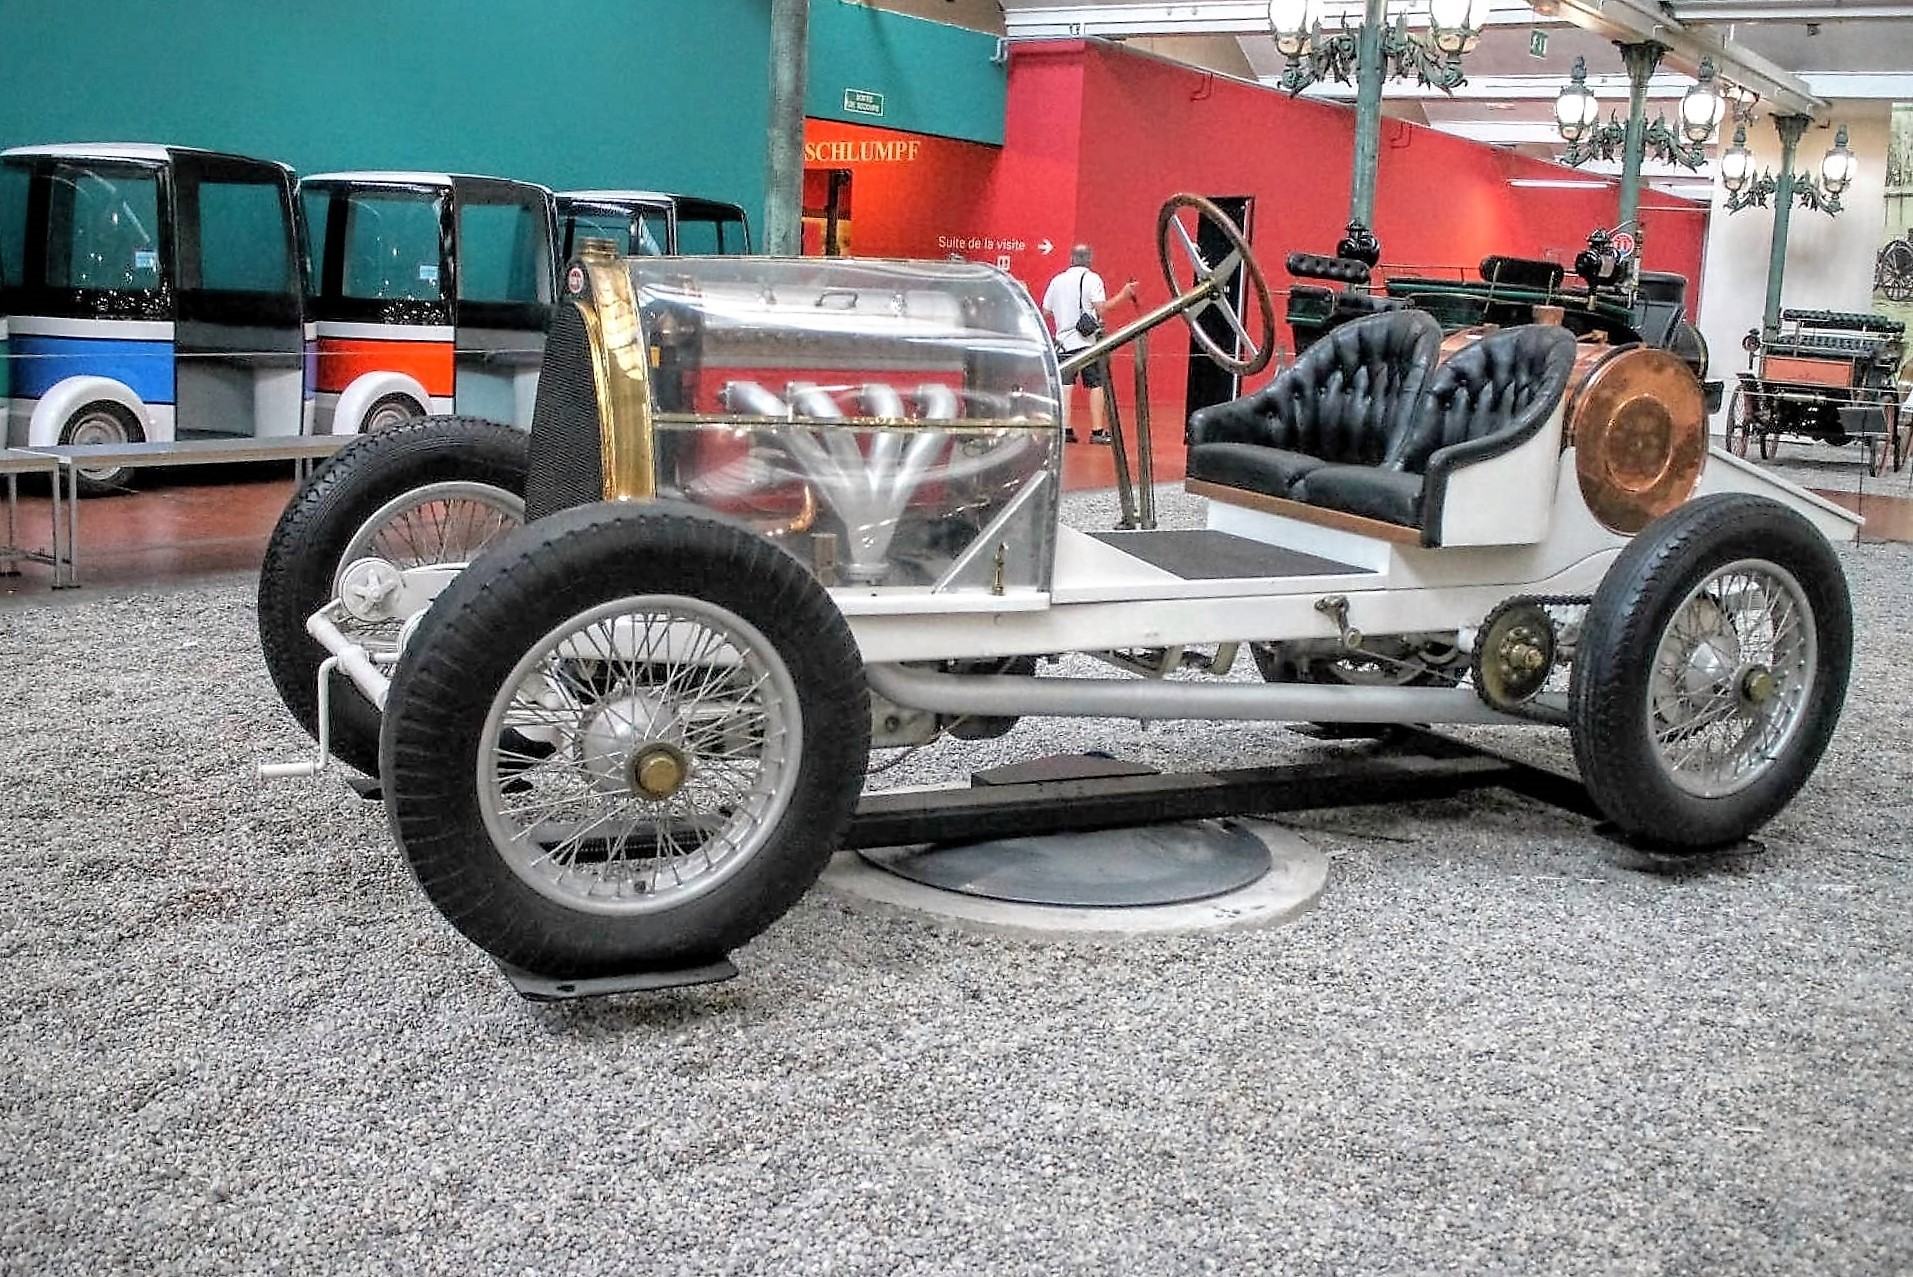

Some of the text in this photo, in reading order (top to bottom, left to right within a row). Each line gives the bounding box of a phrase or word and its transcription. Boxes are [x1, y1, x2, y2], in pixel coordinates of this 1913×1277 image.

[804, 140, 920, 162] SCHLUMPF
[938, 235, 1026, 251] Suite de la visite
